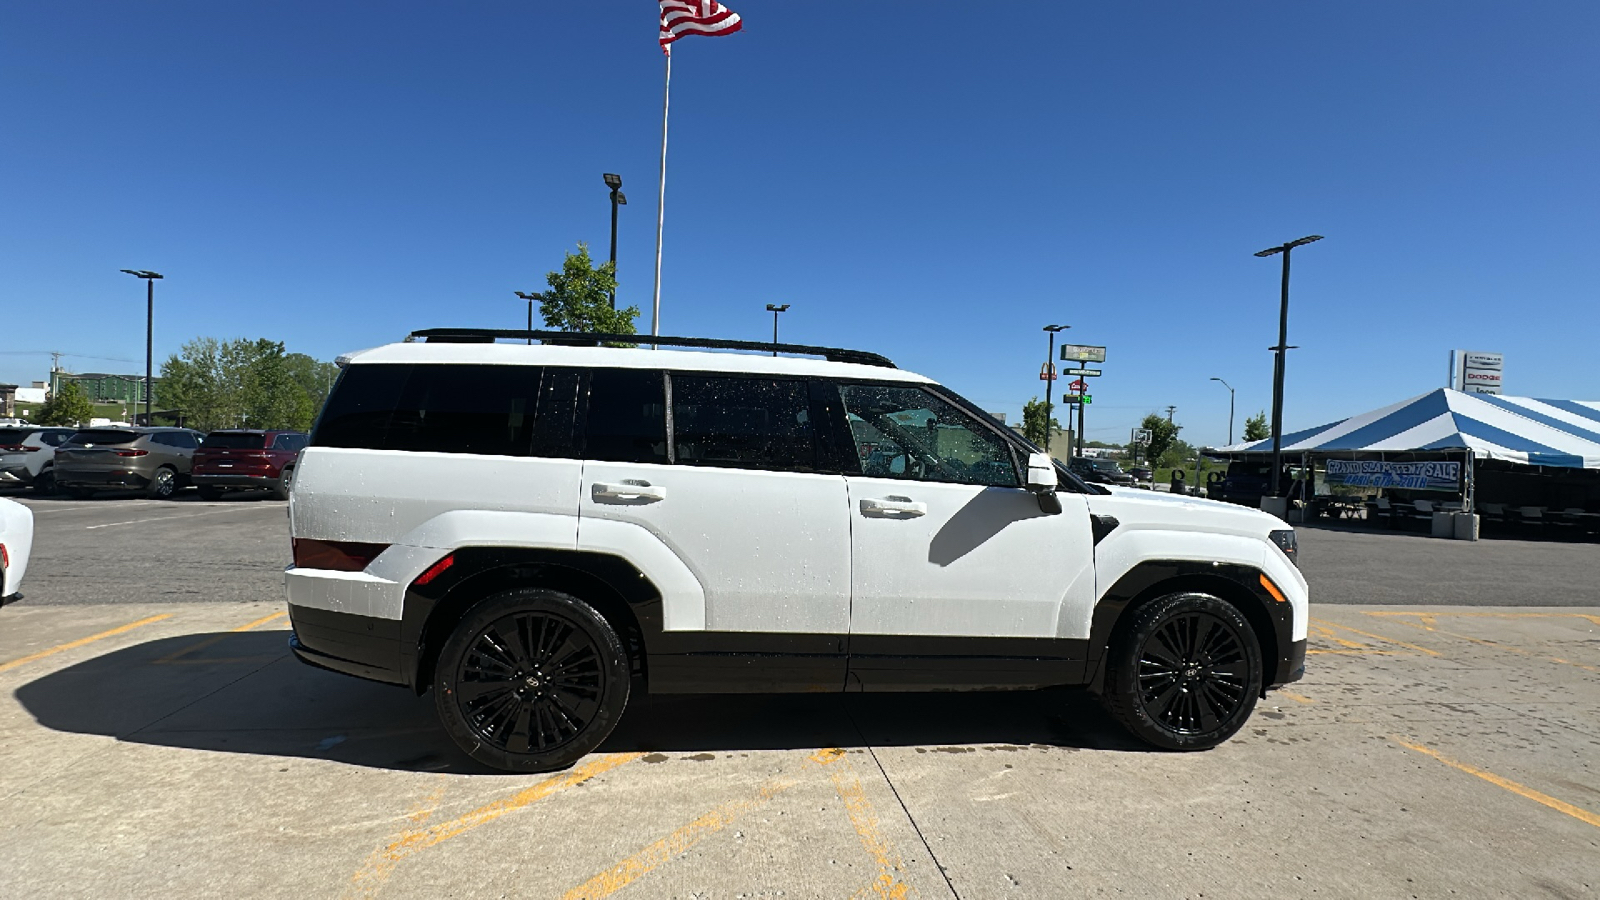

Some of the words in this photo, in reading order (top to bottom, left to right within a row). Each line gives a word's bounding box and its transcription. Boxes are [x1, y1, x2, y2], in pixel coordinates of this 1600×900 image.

[1328, 461, 1360, 475] GRAND
[1362, 462, 1391, 474] SLAM
[1392, 463, 1424, 475] TENT
[1426, 463, 1457, 480] SALE
